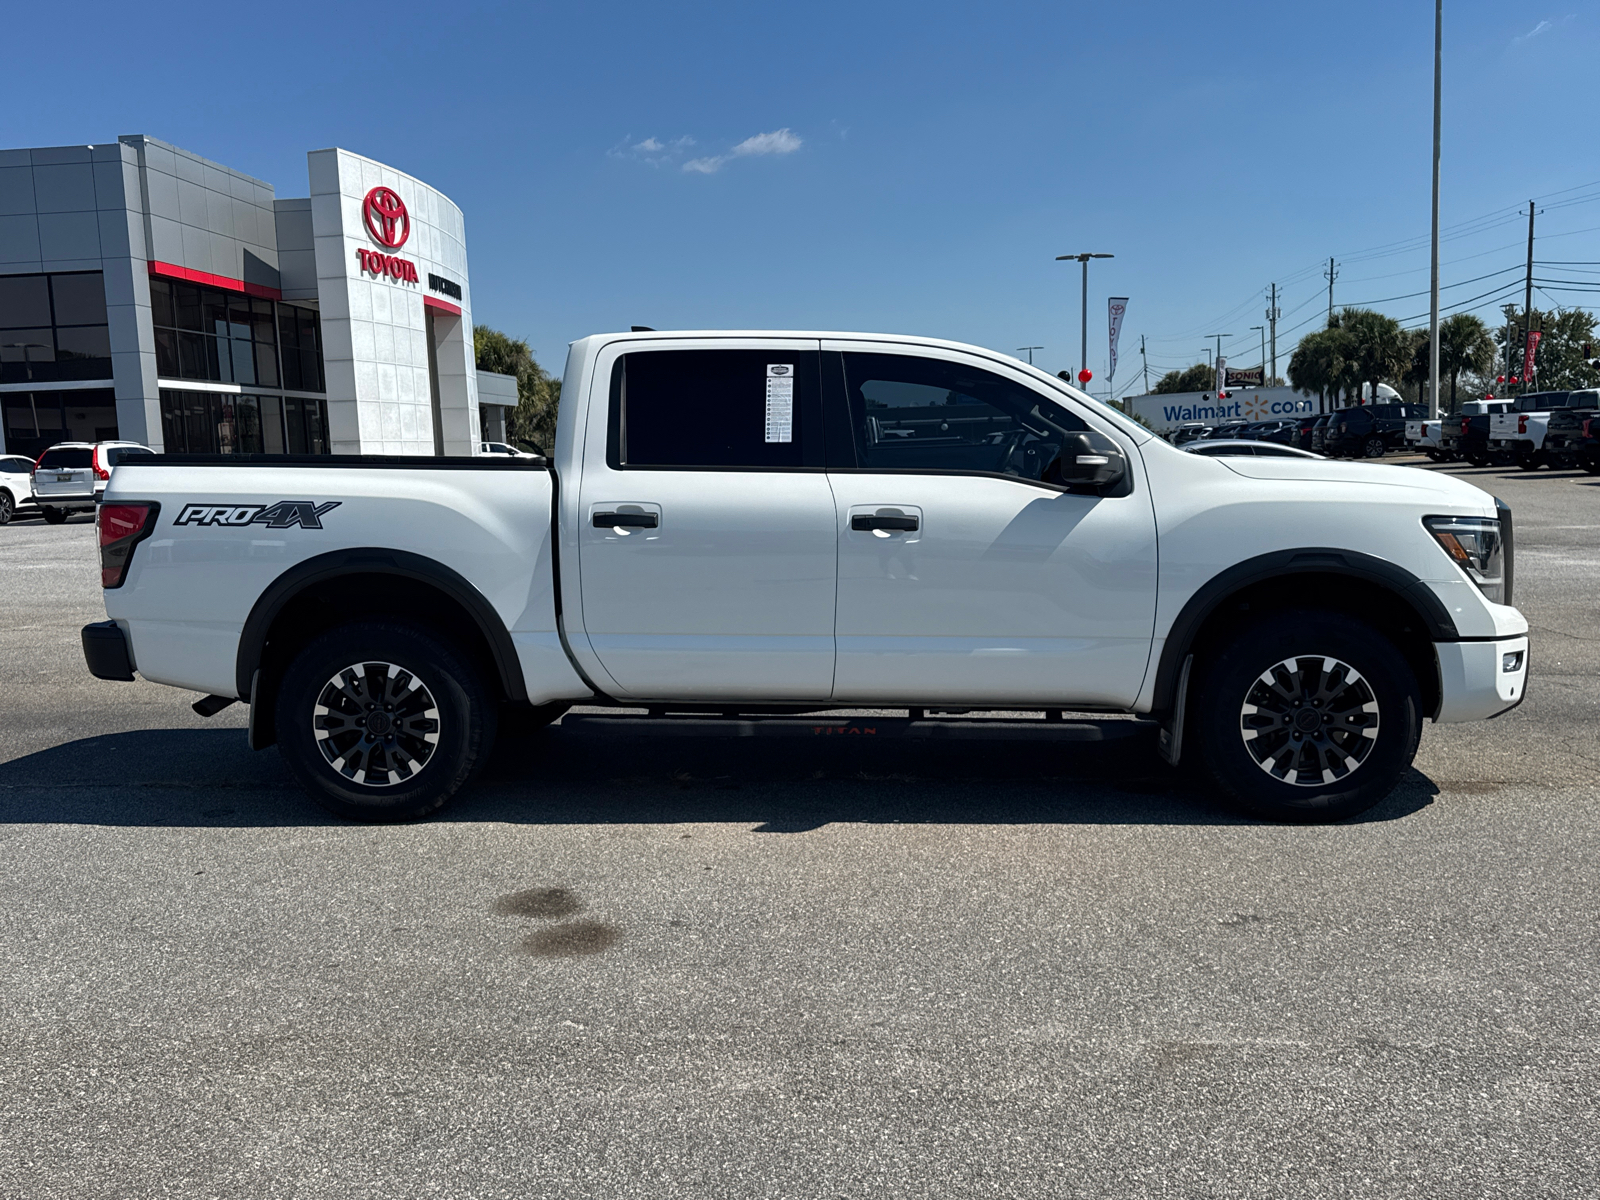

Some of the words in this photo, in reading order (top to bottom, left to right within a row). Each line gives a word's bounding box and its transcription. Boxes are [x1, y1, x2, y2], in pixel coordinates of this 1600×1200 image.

[357, 248, 419, 283] TOYOTA
[1230, 371, 1260, 380] SONIC
[1163, 401, 1241, 421] Walmart
[1271, 400, 1313, 414] com
[813, 727, 876, 735] TITAN
